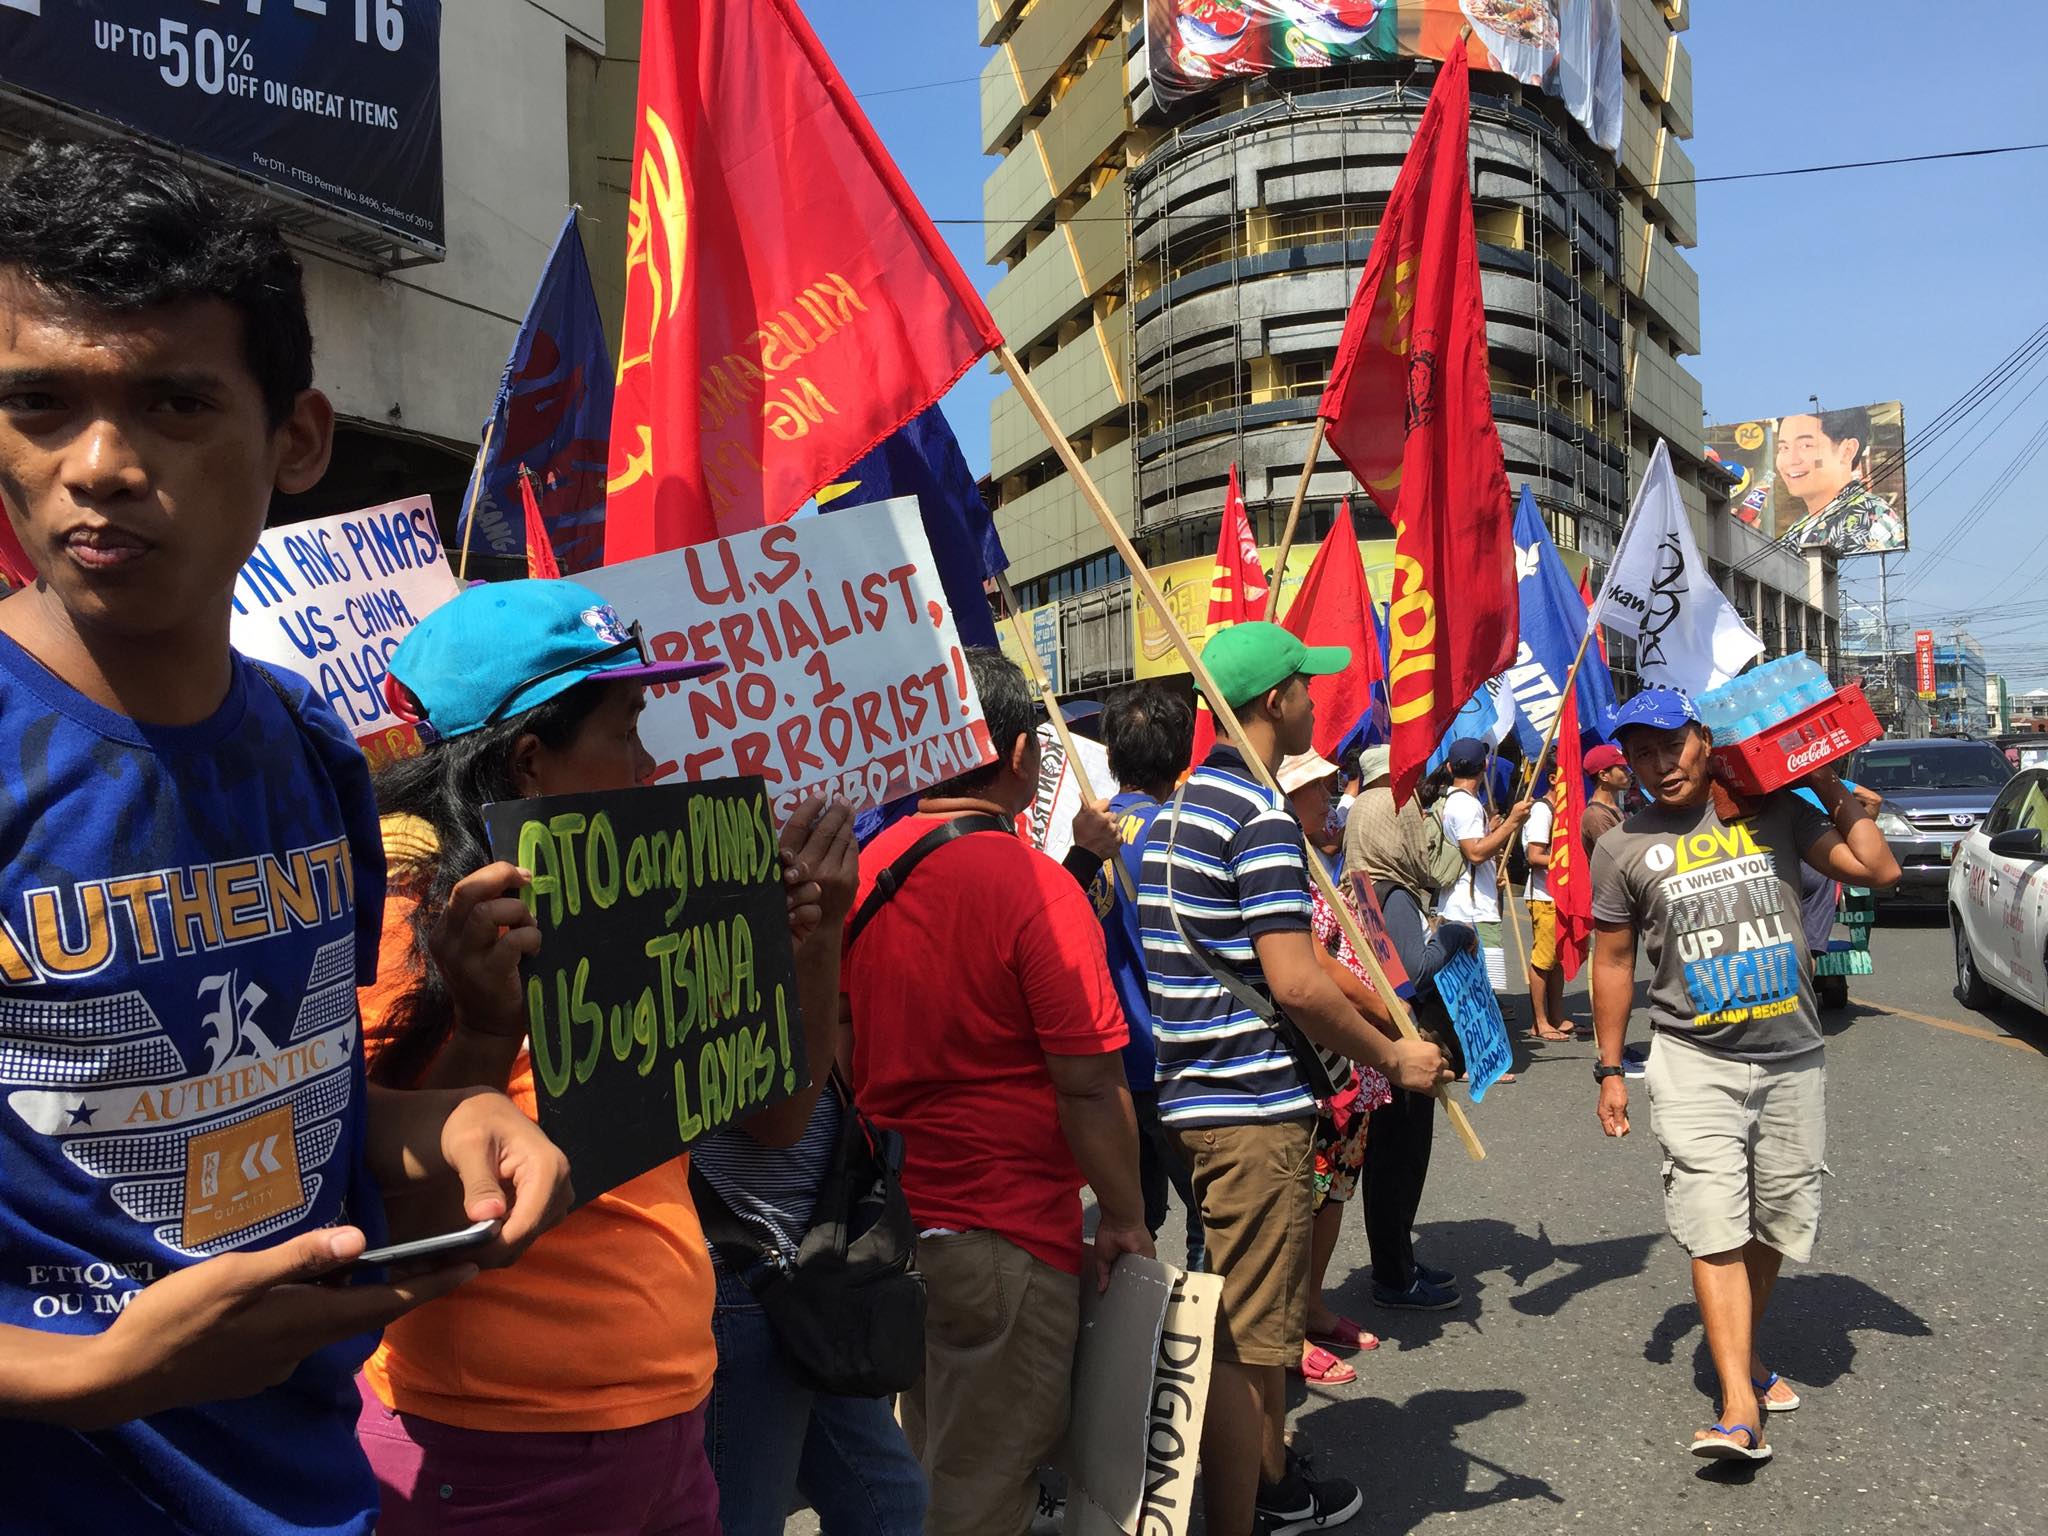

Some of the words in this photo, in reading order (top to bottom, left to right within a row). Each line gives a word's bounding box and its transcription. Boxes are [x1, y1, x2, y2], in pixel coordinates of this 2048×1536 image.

[95, 20, 124, 51] UP
[129, 27, 156, 60] TO
[228, 73, 258, 99] OFF
[264, 80, 287, 107] ON
[292, 88, 344, 119] GREAT
[350, 98, 398, 130] ITEMS
[253, 152, 268, 167] Per
[270, 158, 285, 174] DTI
[291, 167, 313, 185] FTEB
[314, 175, 343, 196] Permit
[343, 188, 358, 202] No.
[381, 203, 405, 219] Series
[405, 213, 414, 224] of
[414, 215, 434, 231] 2019
[284, 528, 351, 589] ANG
[341, 508, 445, 581] PINAS!
[684, 524, 812, 605] U.S.
[645, 563, 944, 697] PERIALIST,
[688, 672, 796, 740] NO.
[805, 650, 846, 708] 1
[1922, 647, 1930, 691] PAWNSHOP
[518, 811, 621, 928] ATO
[626, 829, 687, 927] ang
[688, 793, 781, 887] PINAS!
[1669, 880, 1688, 895] IT
[1689, 868, 1735, 891] WHEN
[1737, 859, 1769, 877] YOU
[1677, 822, 1772, 874] LOVE
[1667, 885, 1739, 934] KEEP
[1745, 876, 1785, 916] ME
[1677, 928, 1724, 963] UP
[1738, 915, 1793, 951] ALL
[1693, 947, 1791, 1011] NIGHT
[528, 957, 603, 1097] US
[610, 985, 657, 1076] ug
[124, 1040, 328, 1123] AUTHENTIC
[674, 983, 796, 1142] LAYAS!
[214, 1188, 274, 1220] QUALITY
[33, 1293, 83, 1318] OU
